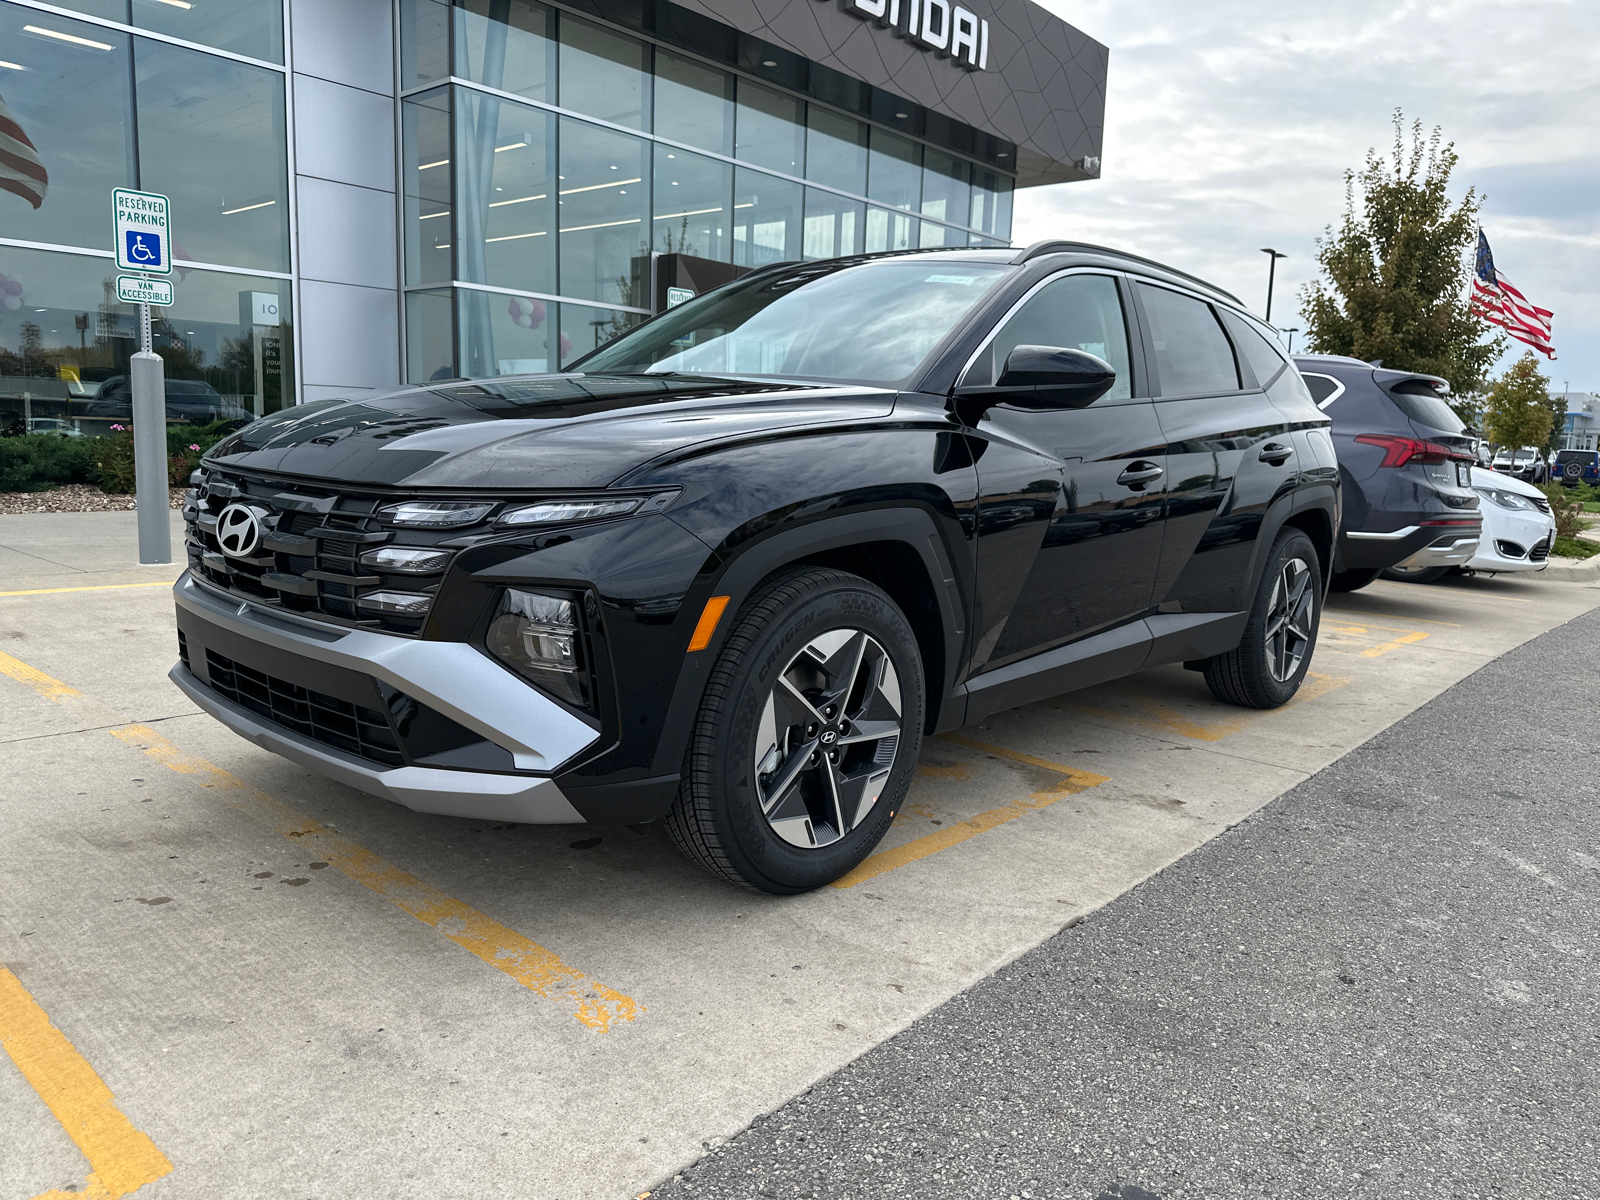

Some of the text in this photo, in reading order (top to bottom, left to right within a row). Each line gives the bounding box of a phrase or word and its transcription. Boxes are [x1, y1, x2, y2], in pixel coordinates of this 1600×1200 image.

[119, 196, 164, 213] RESERVED
[119, 210, 165, 227] PARKING
[138, 281, 153, 290] VAN
[122, 289, 169, 301] ACCESSIBLE
[758, 610, 815, 683] CRUGEN
